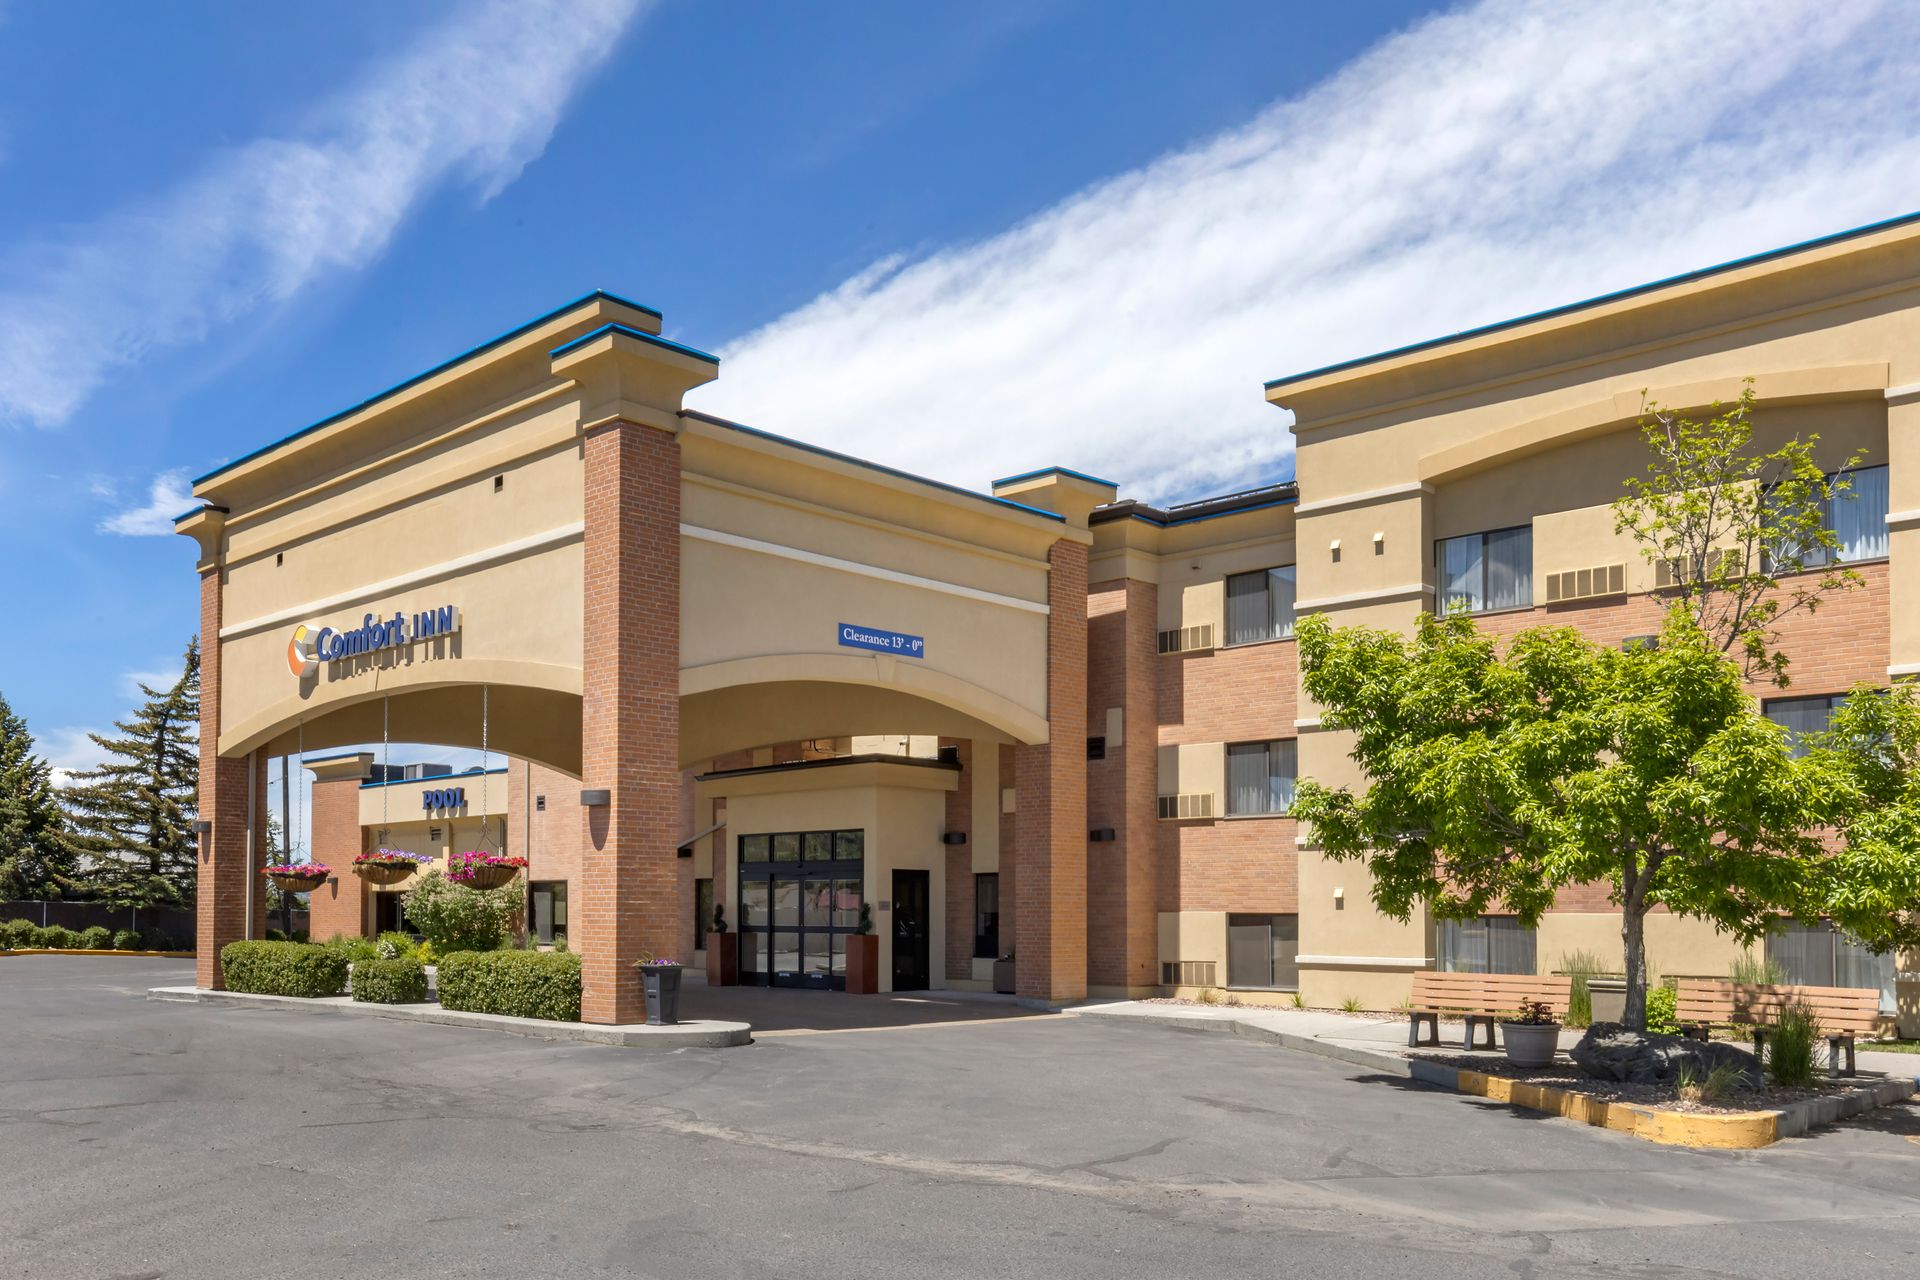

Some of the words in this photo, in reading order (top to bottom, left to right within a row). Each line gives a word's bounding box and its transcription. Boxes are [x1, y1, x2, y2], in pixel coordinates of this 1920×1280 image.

[317, 611, 404, 661] Comfort
[413, 605, 453, 640] INN
[843, 628, 890, 646] Clearance
[422, 787, 465, 810] POOL
